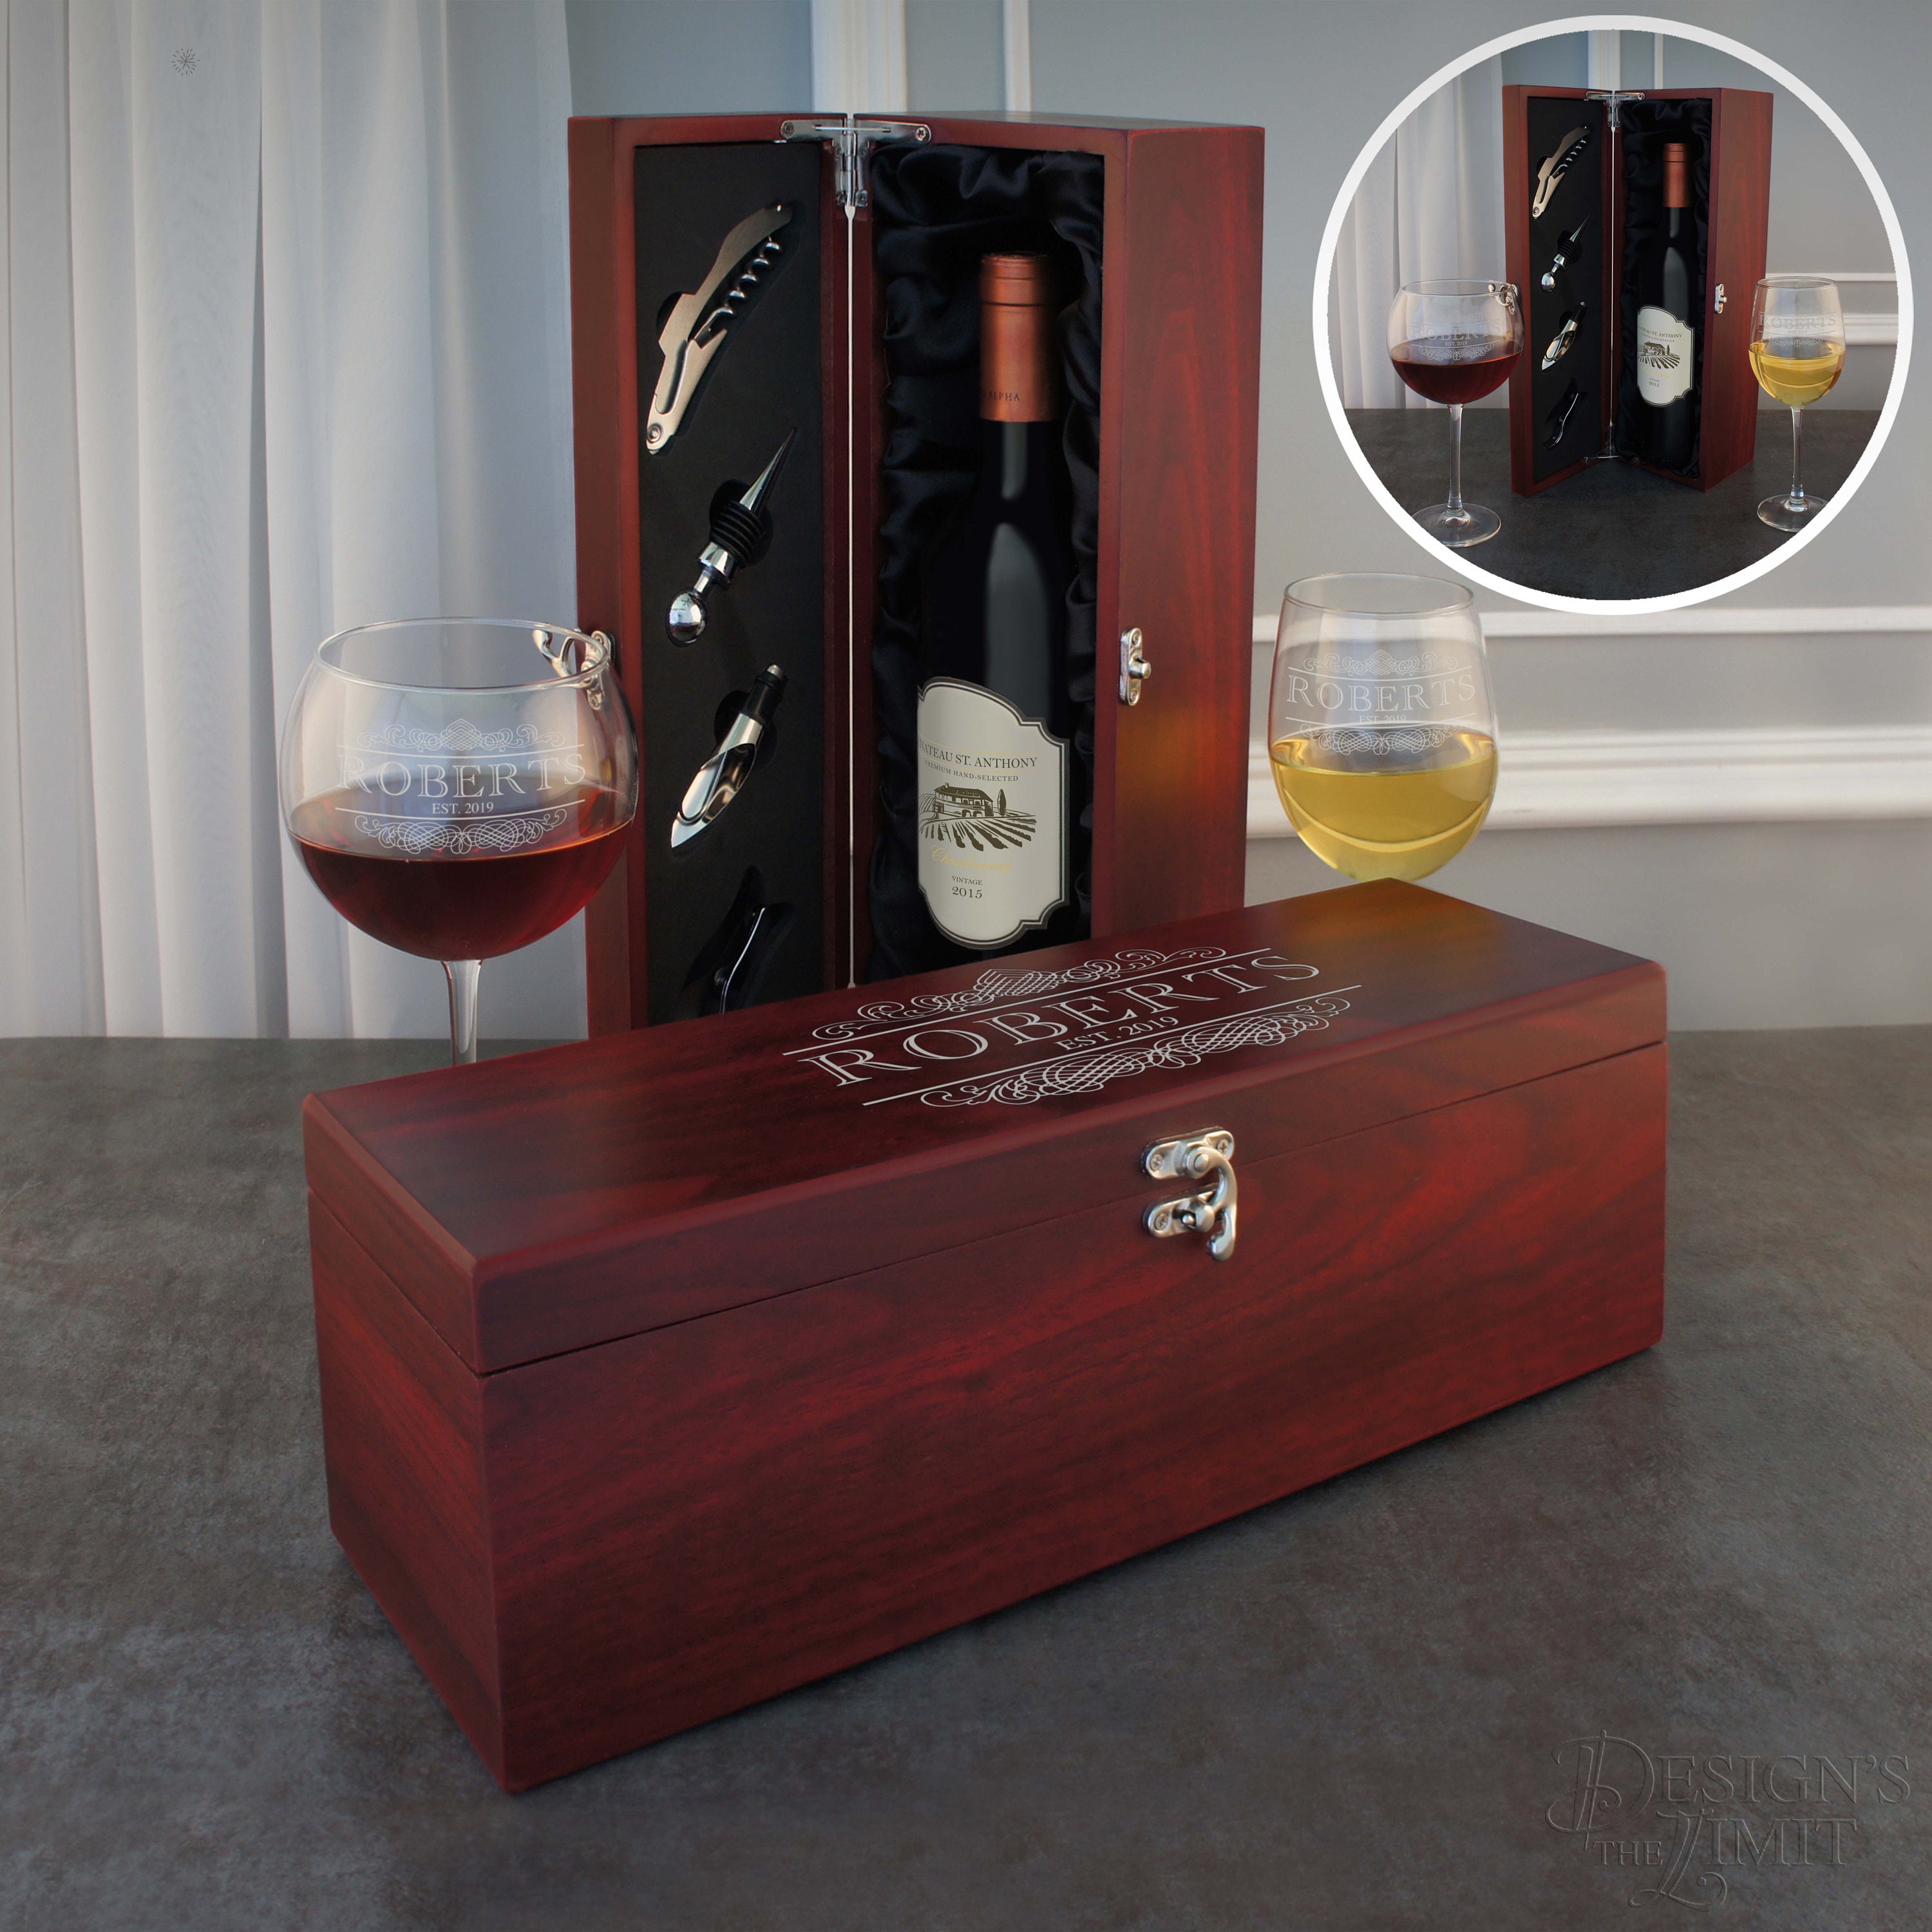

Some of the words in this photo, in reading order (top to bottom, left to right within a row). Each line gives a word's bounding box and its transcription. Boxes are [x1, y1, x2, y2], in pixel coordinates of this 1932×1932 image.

[1410, 322, 1501, 341] ROBERTS
[1759, 314, 1836, 329] ROBERTS
[1286, 674, 1475, 712] ROBERTS
[1384, 714, 1406, 723] 2019
[919, 739, 952, 762] HATEAU
[956, 755, 972, 766] ST.
[974, 757, 1038, 769] ANTHONY
[338, 753, 586, 799] ROBERTS
[925, 760, 951, 775] PREMIUM
[954, 771, 1019, 781] HAND-SELECTED
[431, 802, 461, 815] EST.
[464, 802, 494, 814] 2019
[931, 845, 1014, 875] Chardonnay
[952, 876, 983, 886] VINTAGE
[952, 886, 983, 899] 2015
[798, 956, 1320, 1086] ROBERTS
[1053, 1031, 1122, 1050] EST.
[1118, 1016, 1179, 1036] 2019
